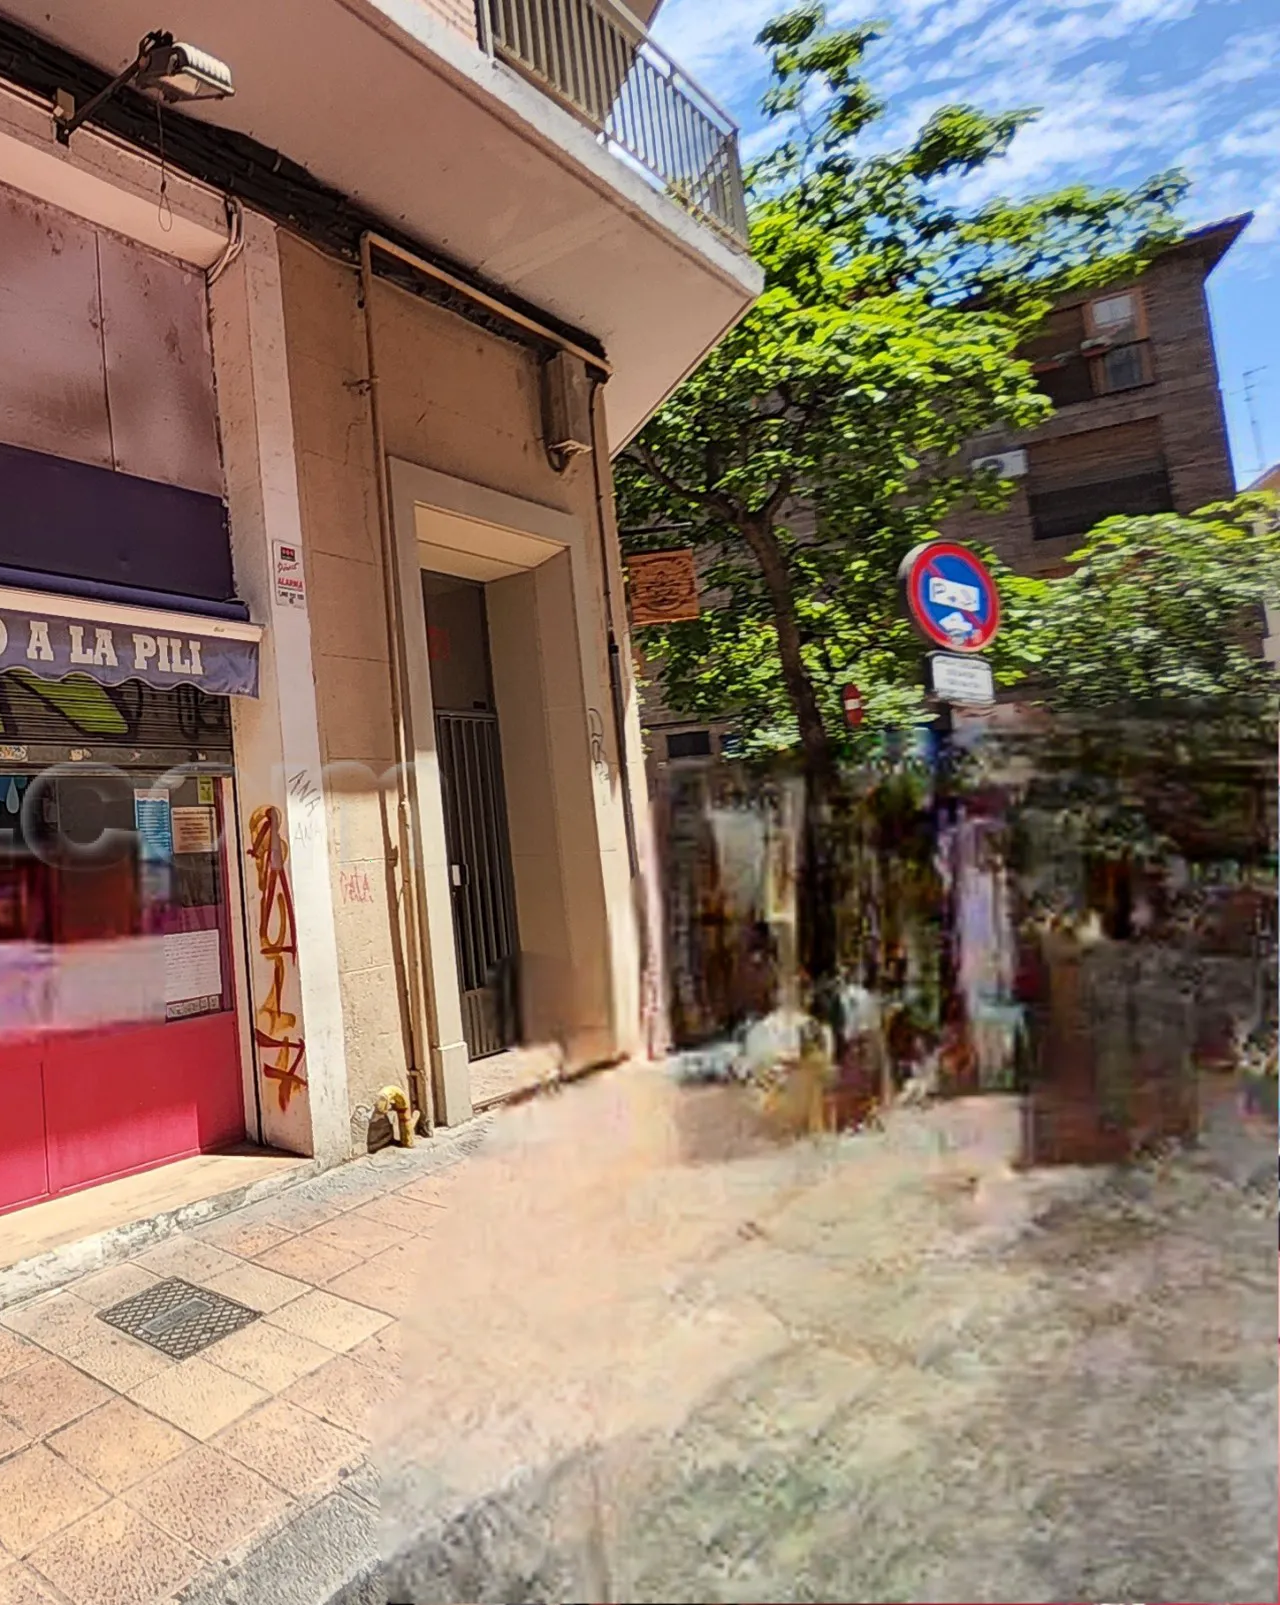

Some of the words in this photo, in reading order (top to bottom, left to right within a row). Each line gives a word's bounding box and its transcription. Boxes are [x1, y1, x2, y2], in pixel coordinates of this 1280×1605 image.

[26, 621, 54, 661] A
[69, 625, 118, 667] LA
[132, 633, 204, 675] PILI
